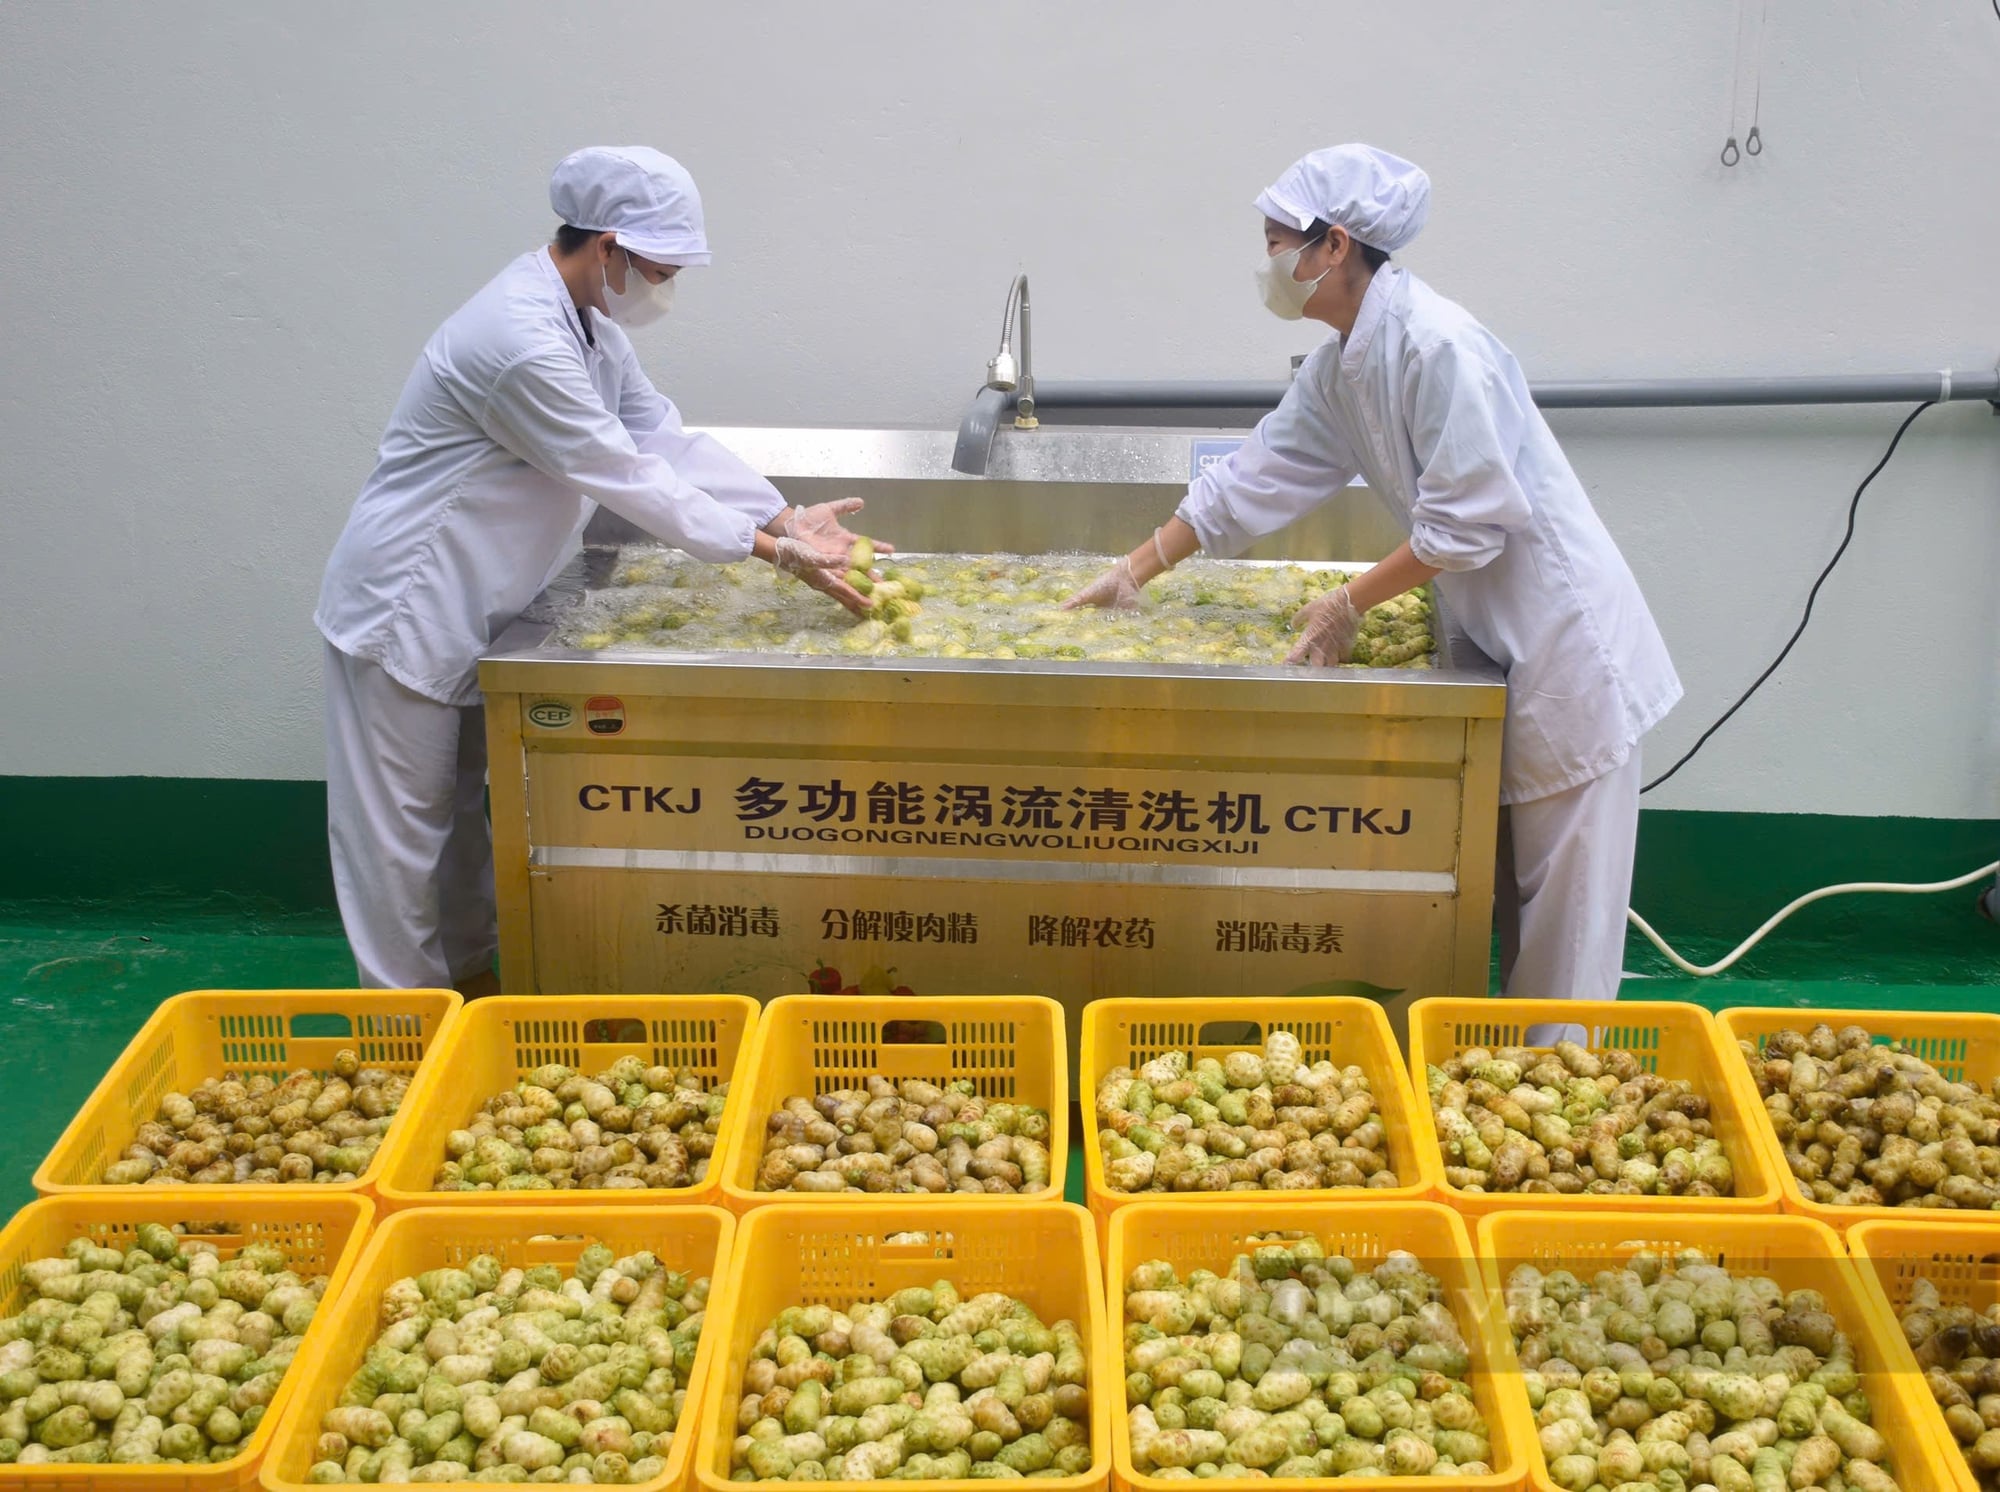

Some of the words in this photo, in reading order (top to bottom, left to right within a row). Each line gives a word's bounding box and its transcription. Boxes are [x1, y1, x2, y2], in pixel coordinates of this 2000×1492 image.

[534, 710, 571, 721] CEP
[578, 784, 702, 814] CTKJ
[735, 777, 1270, 834] 多功能涡流清洗机
[1284, 805, 1411, 835] CTKJ
[744, 825, 1260, 854] DUOGONGNENGWOLIUQINGXIJI
[656, 903, 780, 938] 杀菌消毒
[821, 908, 979, 944] 分解瘦肉精
[1028, 915, 1155, 949] 降解农药
[1216, 920, 1344, 954] 消除毒素
